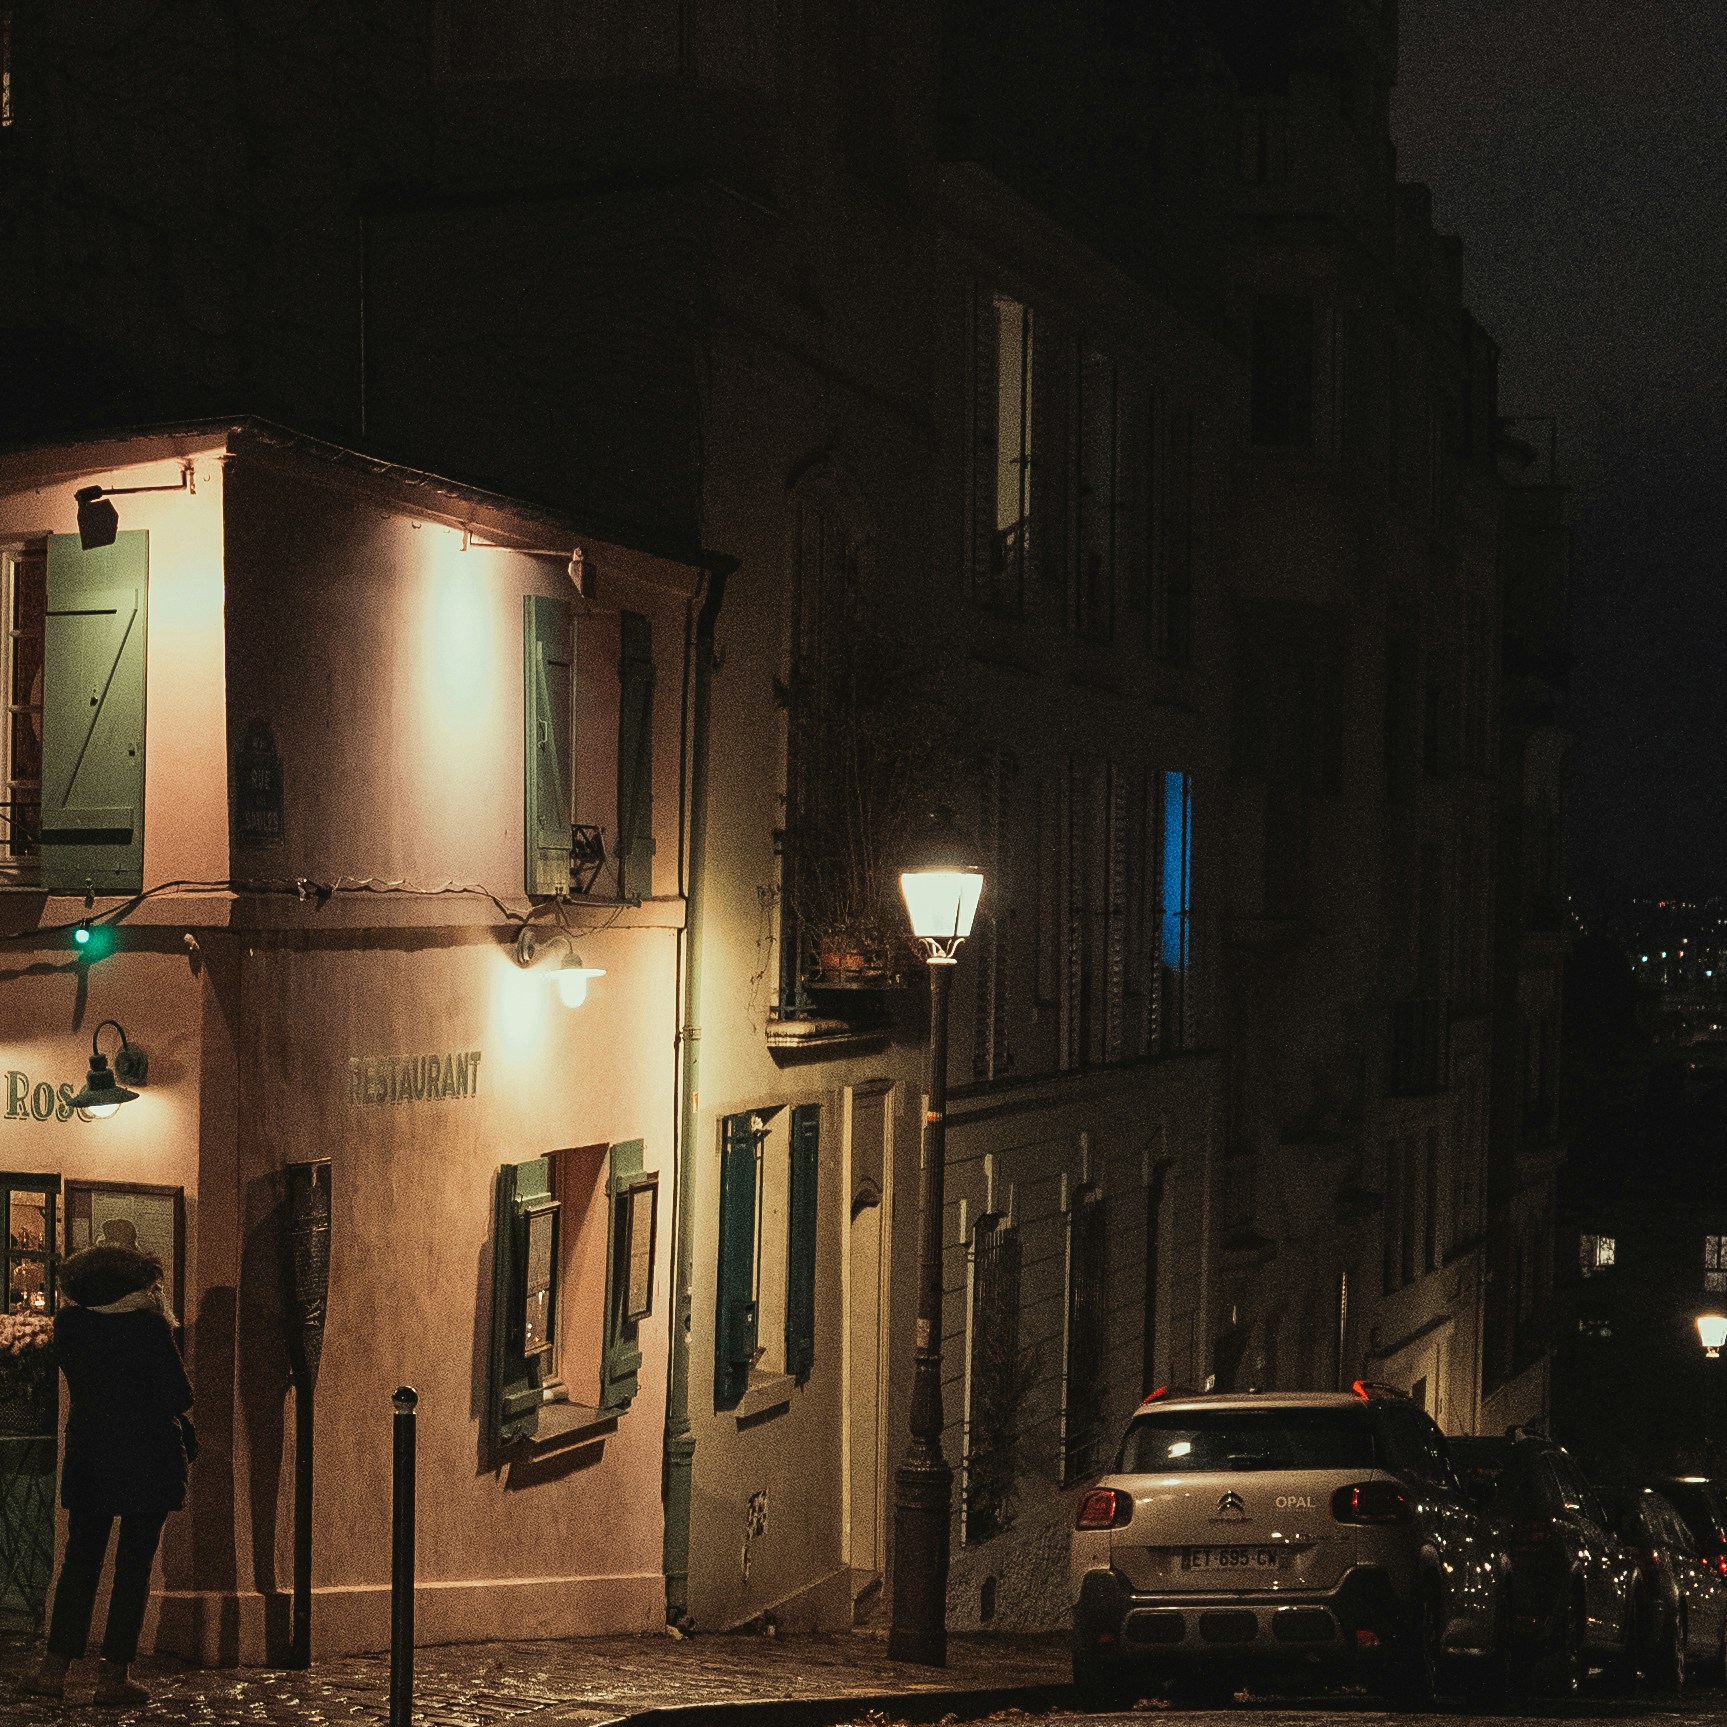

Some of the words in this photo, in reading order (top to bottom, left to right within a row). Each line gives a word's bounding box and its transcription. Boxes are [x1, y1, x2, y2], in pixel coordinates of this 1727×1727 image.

[4, 1070, 95, 1123] Ros
[347, 1051, 482, 1105] RESTAURANT
[1275, 1495, 1316, 1509] OPAL
